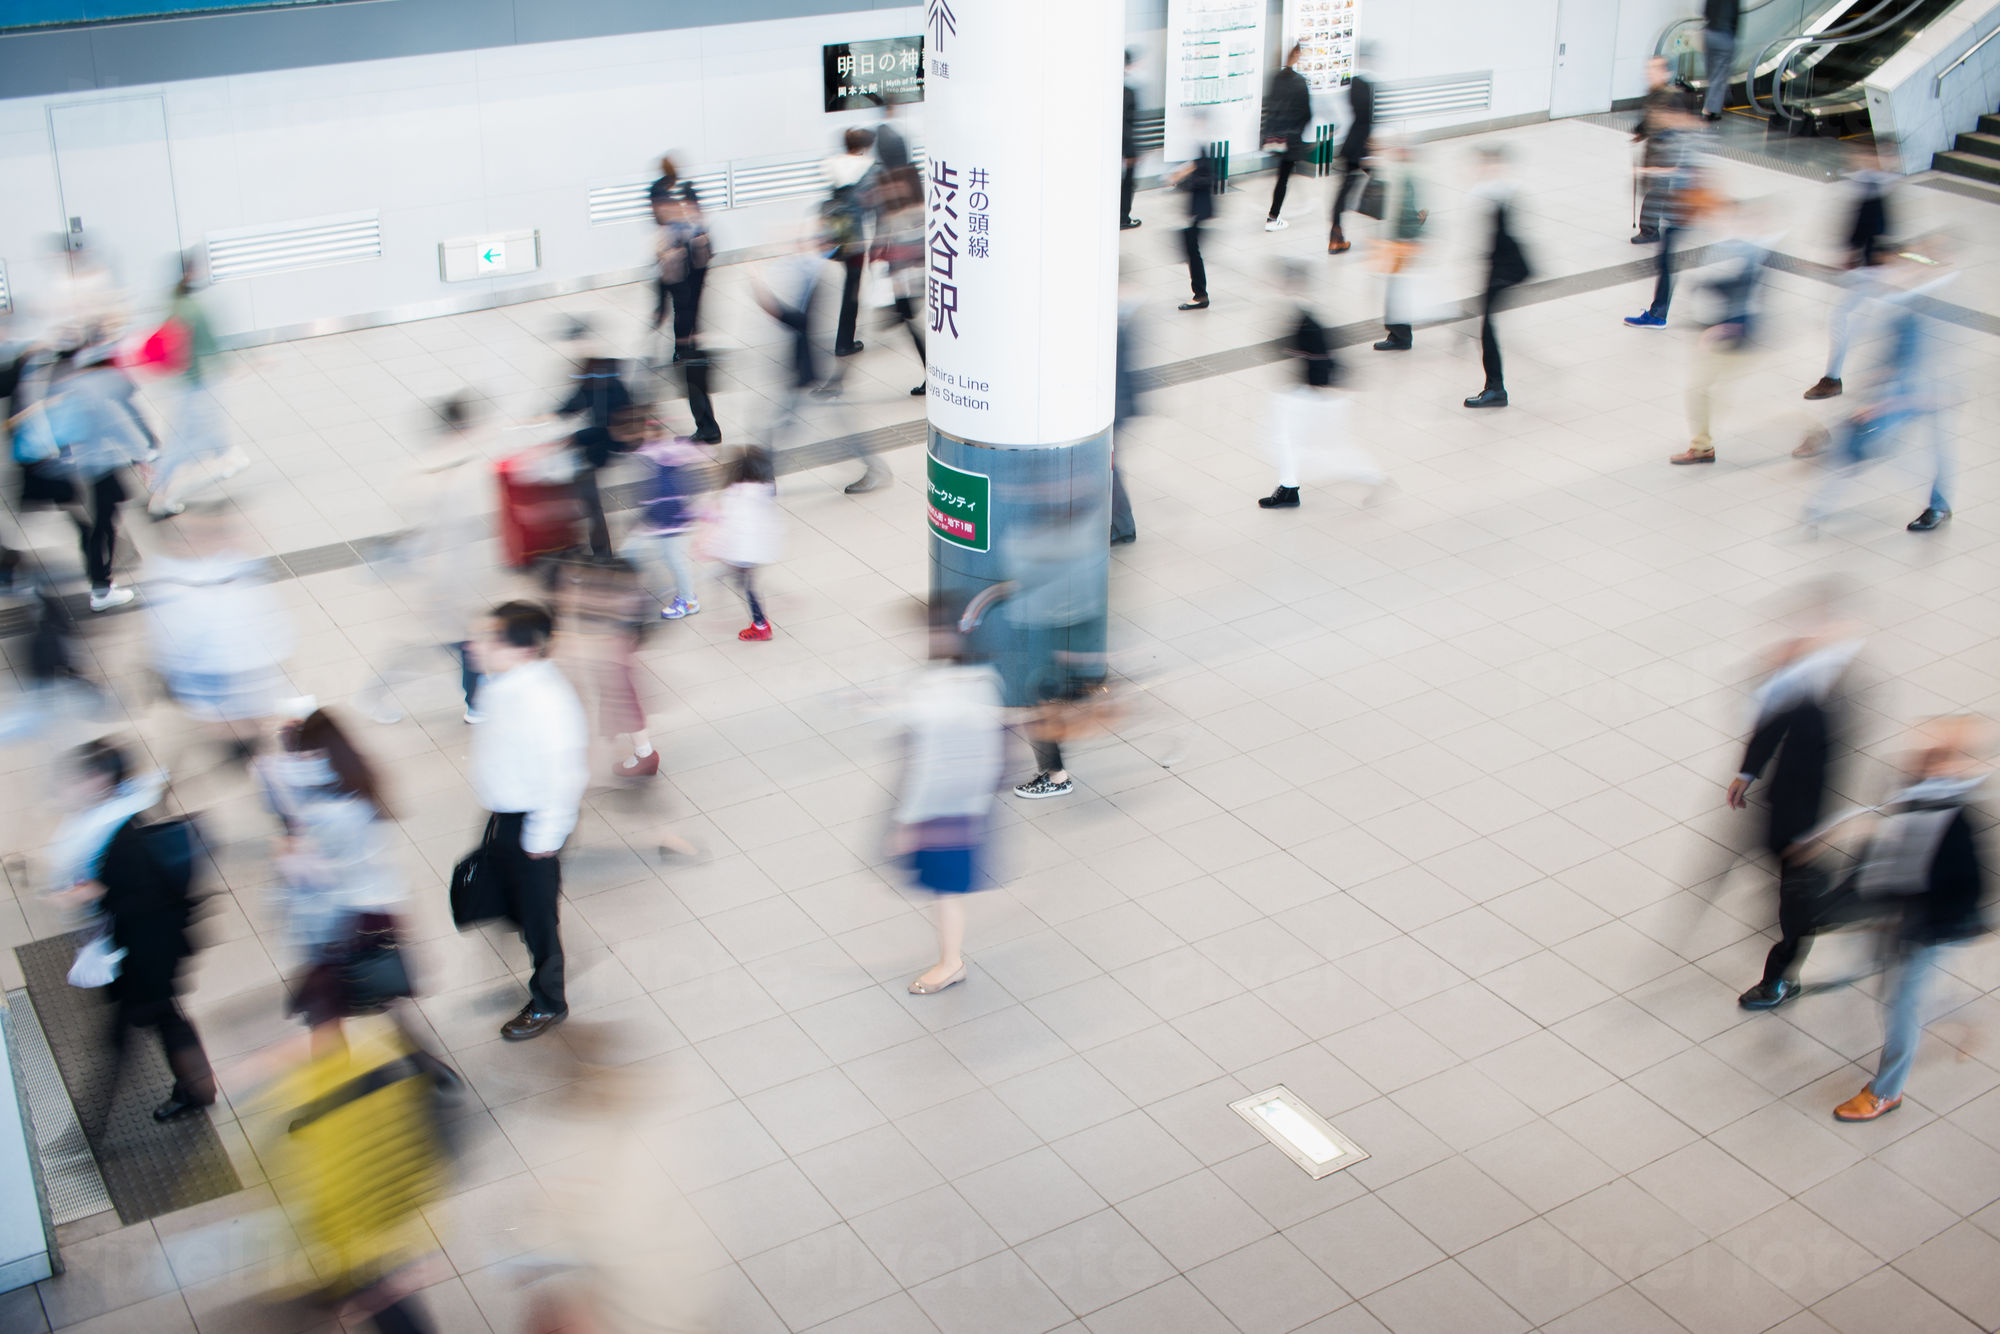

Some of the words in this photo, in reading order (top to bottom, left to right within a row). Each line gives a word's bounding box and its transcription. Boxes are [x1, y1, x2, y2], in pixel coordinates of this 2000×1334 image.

[837, 47, 924, 79] 明日の神
[968, 166, 990, 260] 井の頭線
[928, 156, 959, 340] 渋谷駅
[959, 374, 989, 392] Line
[942, 388, 989, 411] Station
[927, 479, 976, 512] マークシティ
